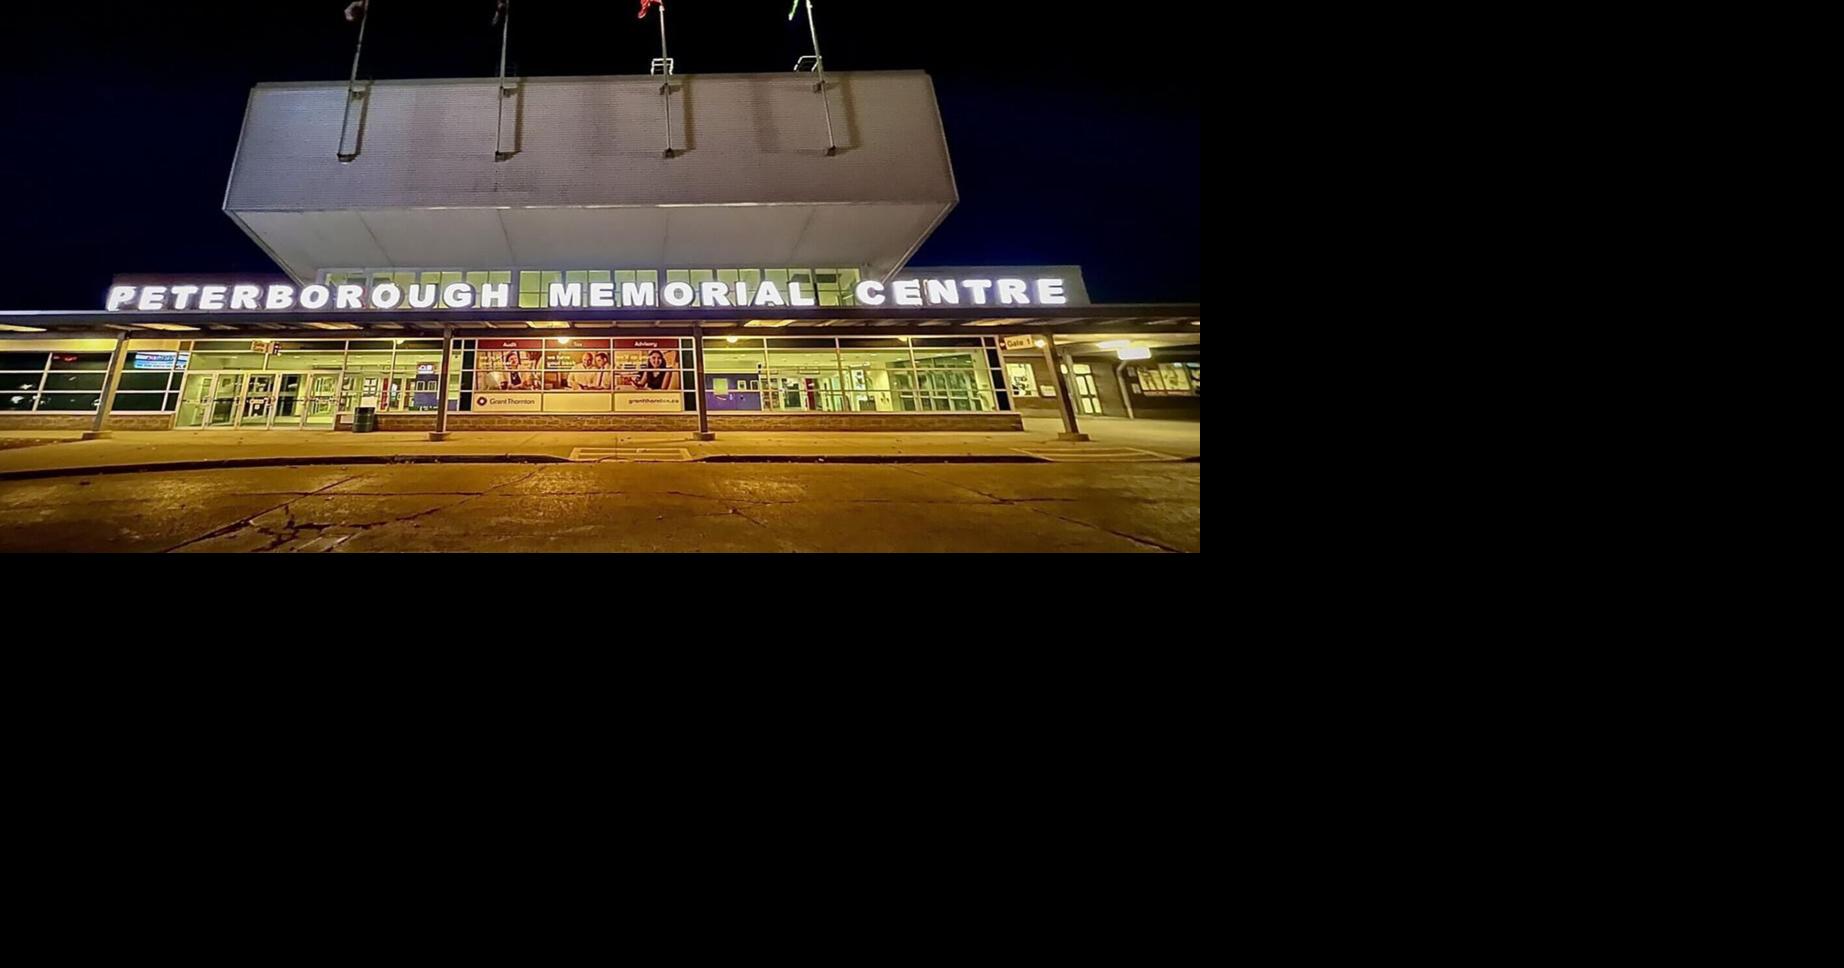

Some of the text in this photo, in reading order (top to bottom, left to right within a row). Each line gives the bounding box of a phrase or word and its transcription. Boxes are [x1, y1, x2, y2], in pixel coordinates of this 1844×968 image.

[106, 278, 1067, 312] PETERBOROUGH MEMORIAL CENTRE
